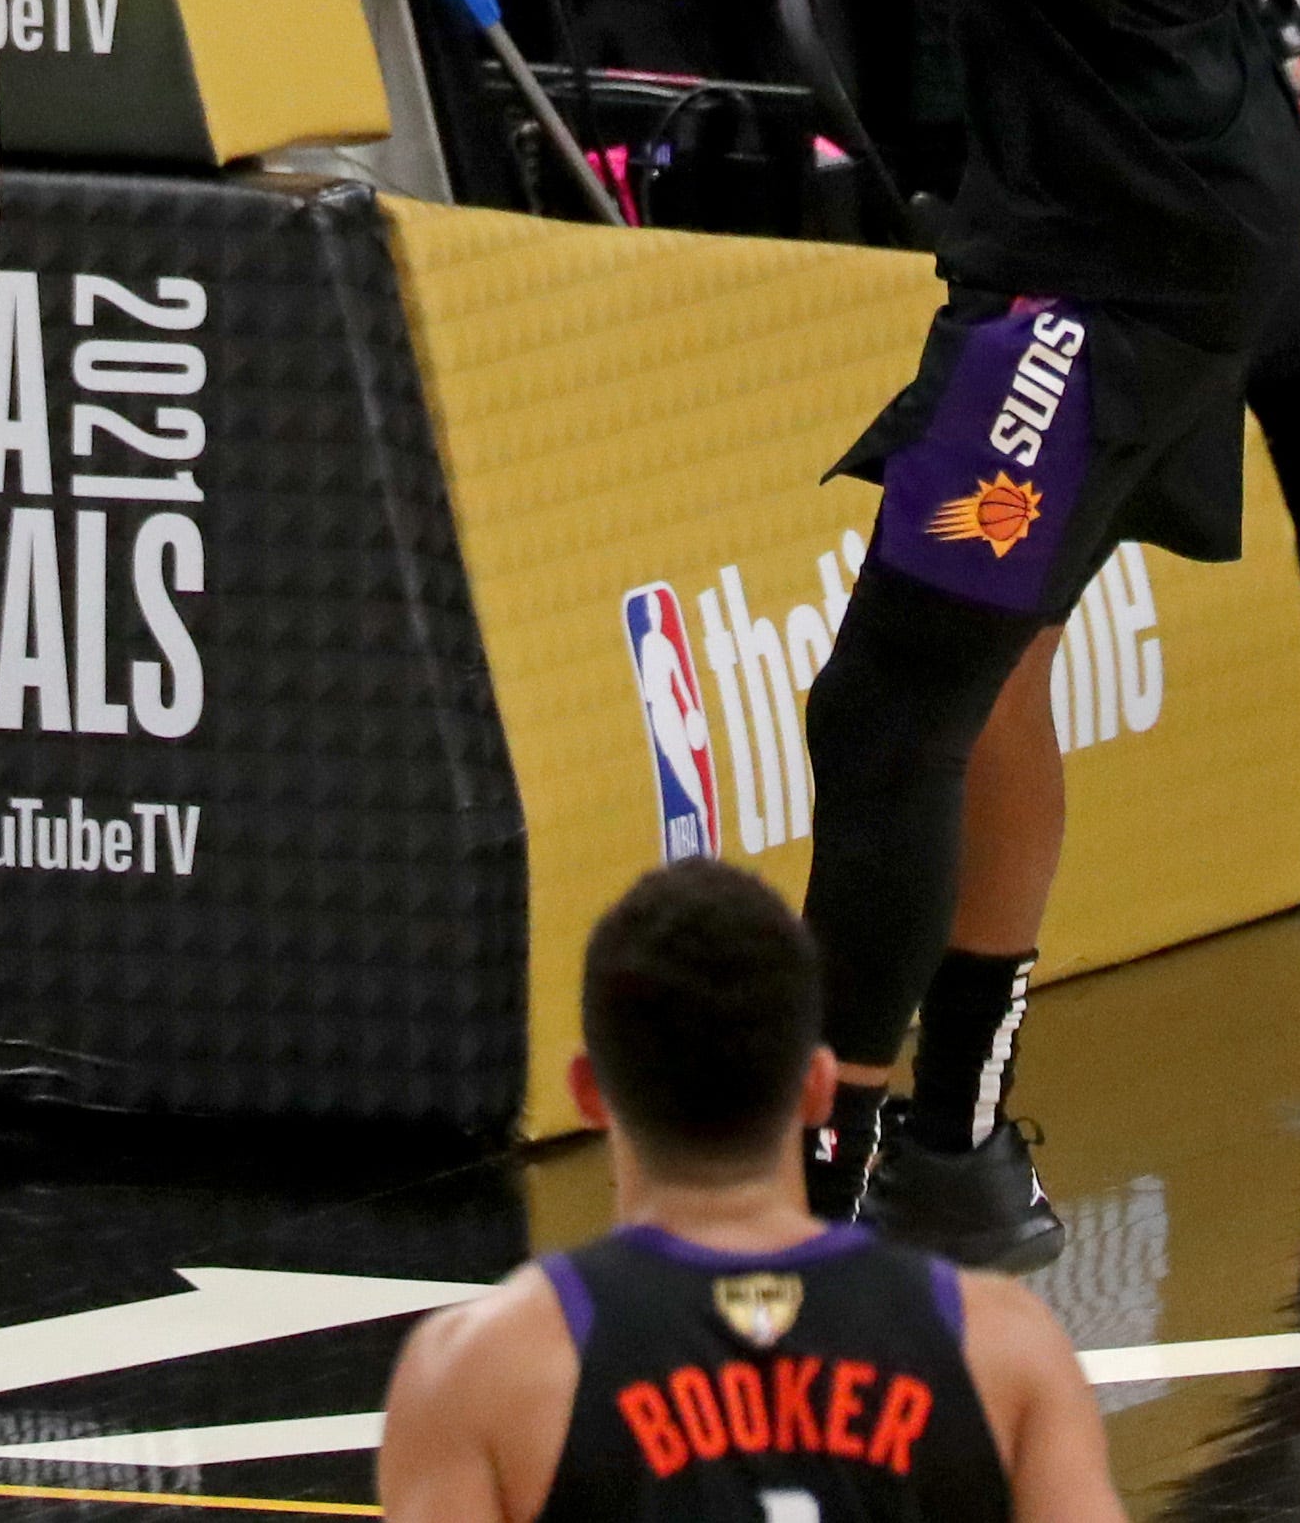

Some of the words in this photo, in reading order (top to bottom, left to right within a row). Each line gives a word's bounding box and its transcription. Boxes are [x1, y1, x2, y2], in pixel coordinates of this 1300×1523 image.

[71, 274, 208, 502] 2021
[989, 311, 1086, 468] SUNS
[616, 1355, 934, 1478] BOOKER
